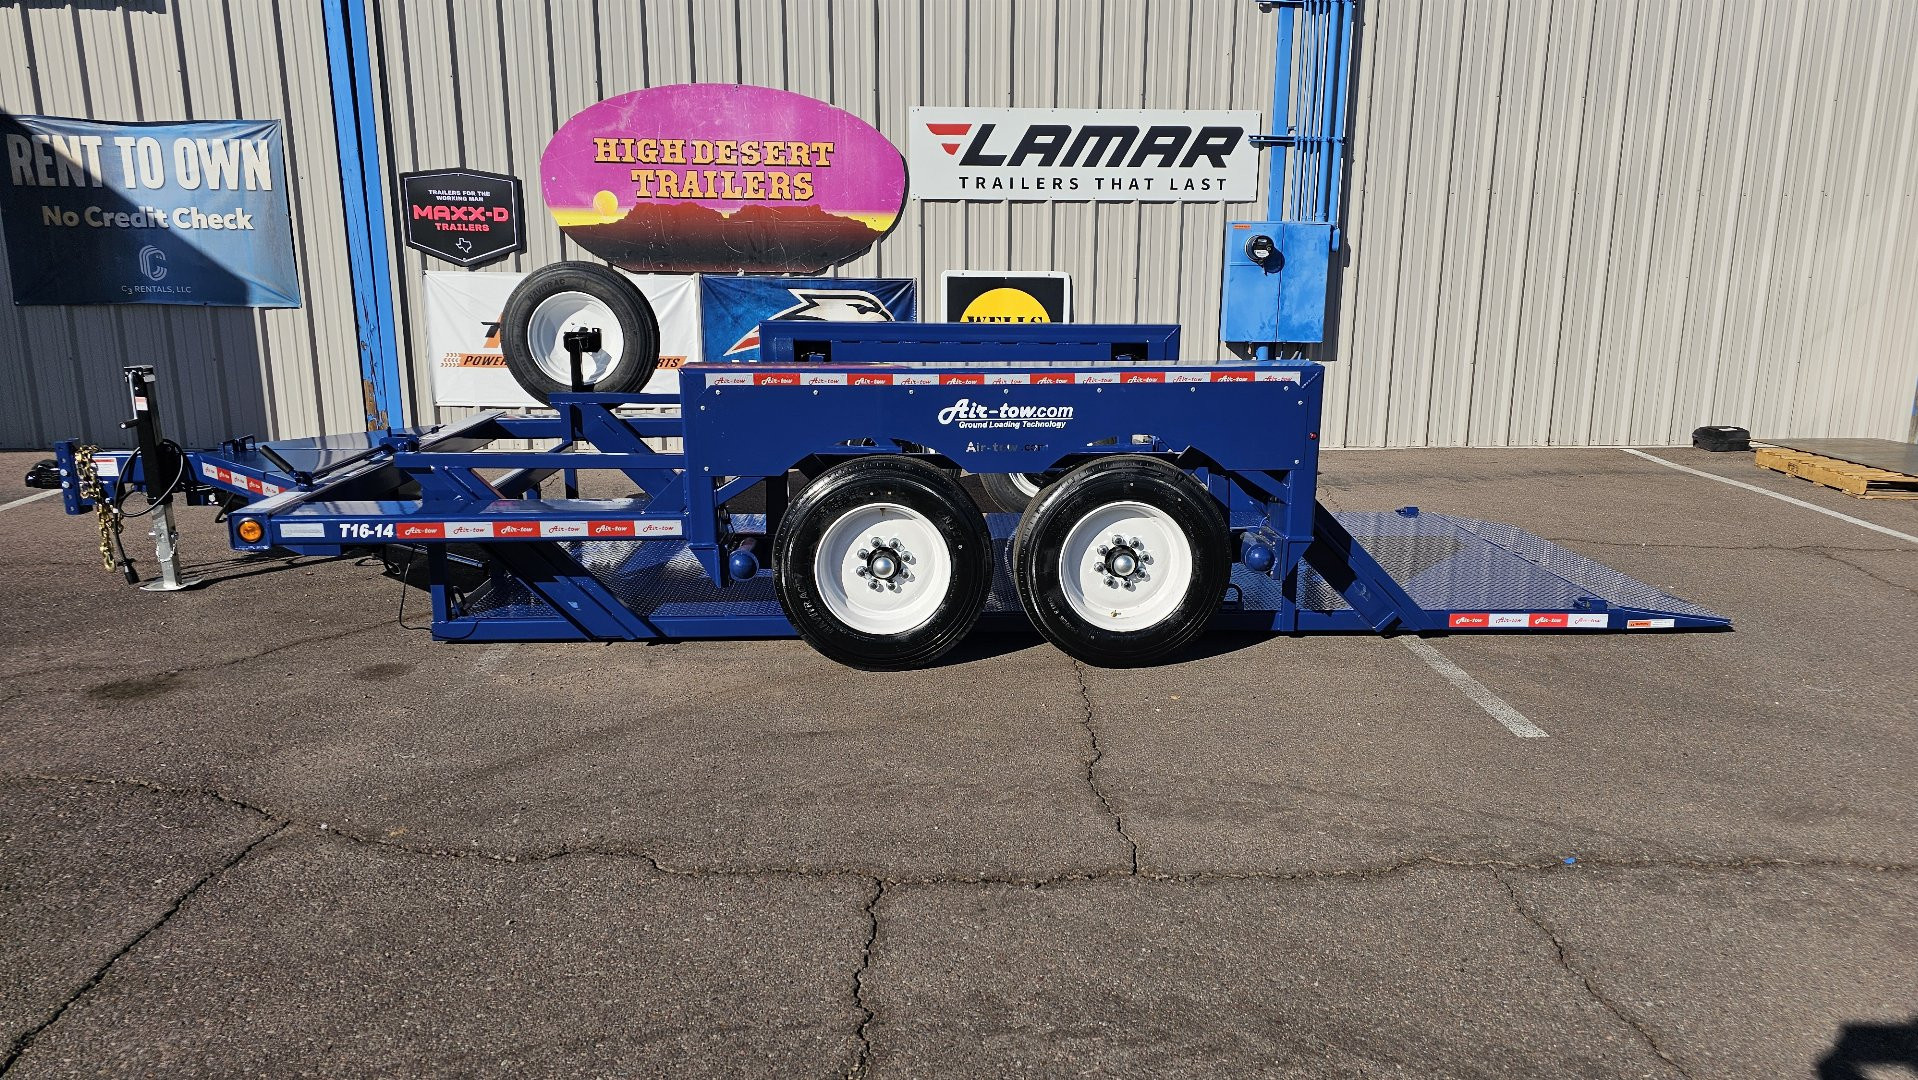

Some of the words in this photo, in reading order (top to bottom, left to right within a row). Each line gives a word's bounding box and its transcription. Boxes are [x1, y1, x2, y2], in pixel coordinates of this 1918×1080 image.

[959, 124, 1244, 168] LAMAR
[593, 138, 687, 165] HIGH
[691, 140, 835, 168] DESERT
[6, 133, 103, 188] RENT
[114, 136, 165, 190] TO
[173, 137, 273, 191] OWN
[631, 169, 815, 201] TRAILERS
[959, 177, 1080, 191] TRAILERS
[1095, 177, 1154, 191] THAT
[1169, 178, 1228, 191] LAST
[42, 205, 80, 228] No
[84, 205, 169, 229] Credit
[172, 206, 255, 230] Check
[412, 204, 509, 222] MAXX-D
[434, 222, 490, 232] TRAILERS
[134, 285, 175, 294] RENTALS,
[176, 285, 192, 293] LLC
[714, 376, 746, 385] Air-tow
[761, 376, 793, 385] Air-tow
[808, 377, 839, 385] Air-tow
[854, 377, 886, 385] Air-tow
[900, 377, 931, 385] Air-tow
[946, 377, 978, 385] Air-tow
[937, 398, 1074, 425] Air-tow.com
[958, 421, 988, 429] Ground
[989, 421, 1020, 430] Loading
[1022, 420, 1067, 430] Technology
[339, 523, 393, 538] T16-14
[404, 526, 438, 536] Air-tow
[453, 526, 485, 534] Air-tow
[500, 525, 533, 534] Air-tow
[548, 525, 581, 534] Air-tow
[595, 524, 628, 533] Air-tow
[642, 524, 674, 532] Air-tow
[1455, 616, 1483, 625] Air-tow
